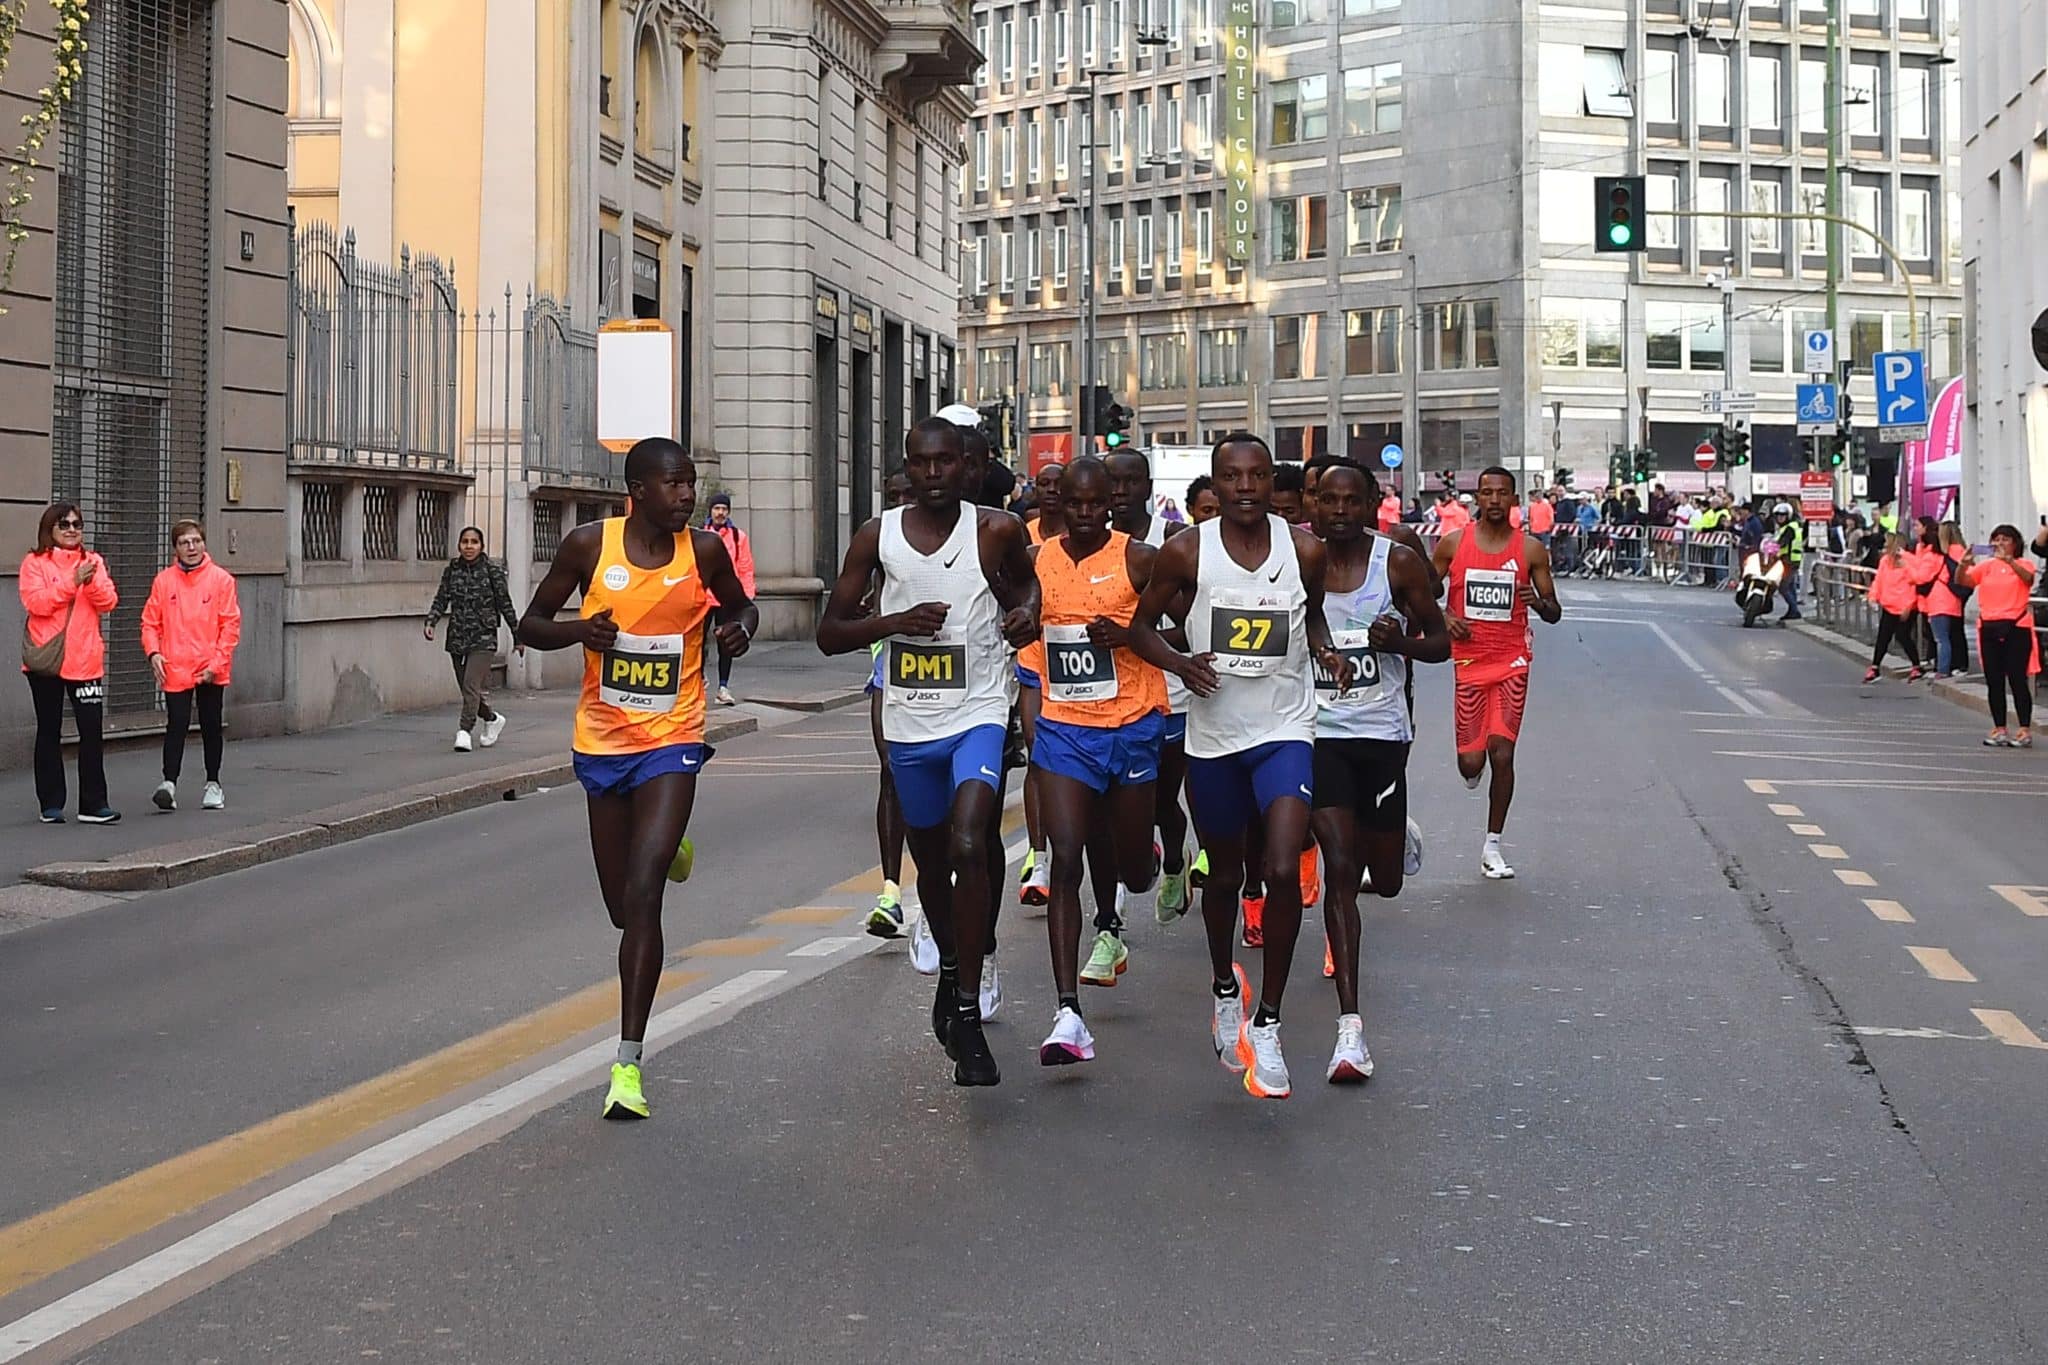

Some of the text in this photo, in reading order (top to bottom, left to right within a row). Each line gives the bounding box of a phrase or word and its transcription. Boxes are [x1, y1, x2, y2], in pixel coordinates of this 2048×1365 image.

[1232, 3, 1249, 13] HC
[1234, 26, 1248, 254] HOTEL CAVOUR
[1885, 356, 1912, 392] P
[1469, 586, 1510, 605] YEGON
[1229, 617, 1272, 650] 27
[612, 658, 670, 688] PM3
[900, 652, 953, 680] PM1
[1059, 650, 1095, 677] TOO
[1241, 659, 1264, 669] asics
[629, 696, 653, 706] asics
[917, 691, 941, 701] asics
[1074, 686, 1093, 694] asics
